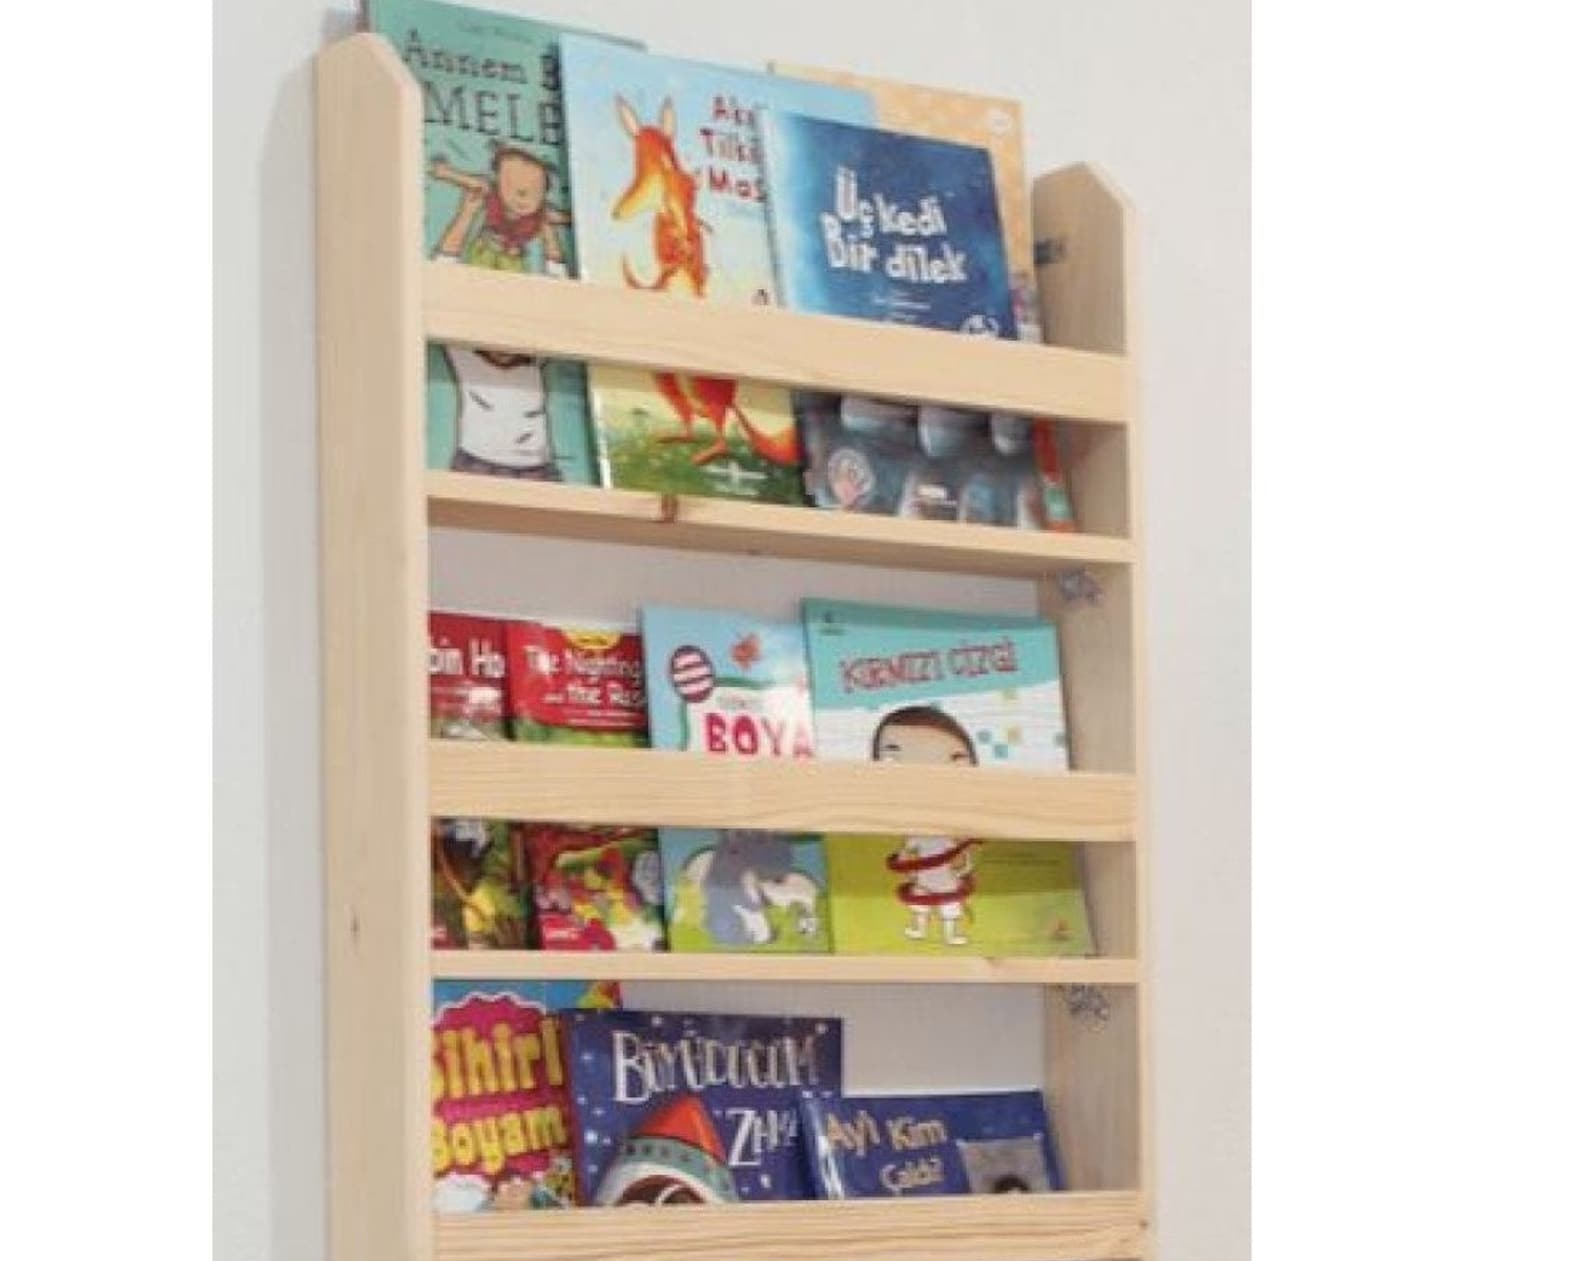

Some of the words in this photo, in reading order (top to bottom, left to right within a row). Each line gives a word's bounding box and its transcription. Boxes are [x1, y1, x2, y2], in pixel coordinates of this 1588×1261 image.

[402, 28, 527, 84] Annem
[834, 163, 875, 239] Üç
[871, 191, 948, 238] kedi
[820, 211, 880, 274] Bir
[884, 241, 969, 285] dilek
[885, 1114, 948, 1152] Kim
